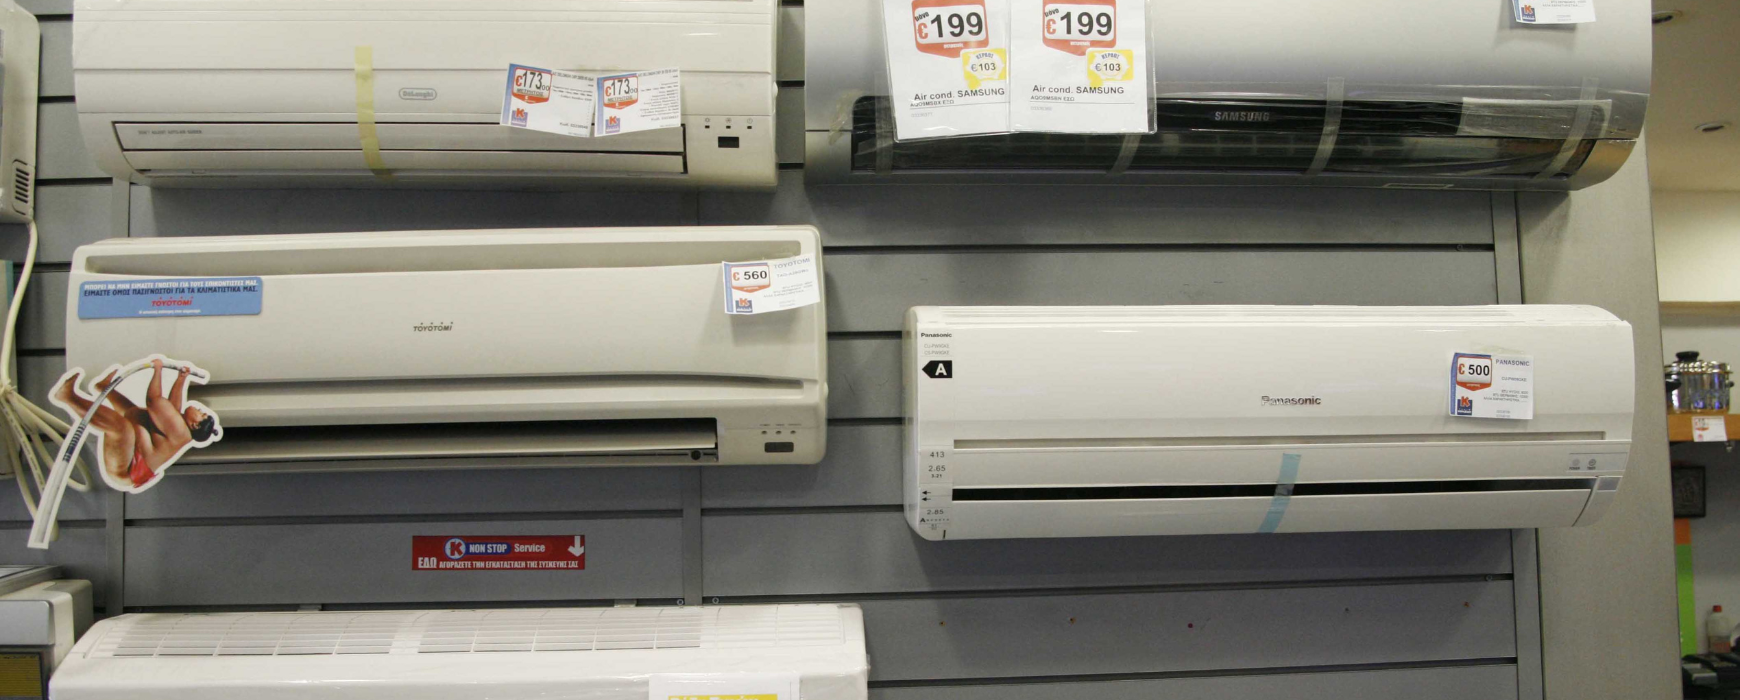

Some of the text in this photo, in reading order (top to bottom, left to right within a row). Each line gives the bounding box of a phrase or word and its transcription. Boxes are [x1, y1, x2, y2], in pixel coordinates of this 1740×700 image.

[930, 91, 955, 100] cond.
[957, 88, 1005, 98] SAMSUNG
[1048, 86, 1073, 94] cond.
[1076, 86, 1125, 94] SAMSUNG
[1214, 111, 1270, 121] SAMSUNG
[773, 258, 810, 269] TOYOTOMI
[744, 271, 767, 280] 560
[84, 289, 110, 297] ΕΙΜΑΣΤΕ
[196, 286, 241, 294] ΚΛΙΜΑΤΙΣΤΙΚΑ
[152, 298, 193, 307] TOYOTOMI
[413, 323, 453, 332] TOYOTOMI
[935, 363, 947, 376] A
[1468, 364, 1490, 376] 500
[1261, 395, 1322, 406] Panasonic
[469, 543, 486, 553] NON
[487, 543, 507, 553] STOP
[514, 543, 546, 552] Service
[418, 557, 437, 569] ΕΔΩ
[439, 561, 471, 569] ΑΓΟΡΑΖΕΤΕ
